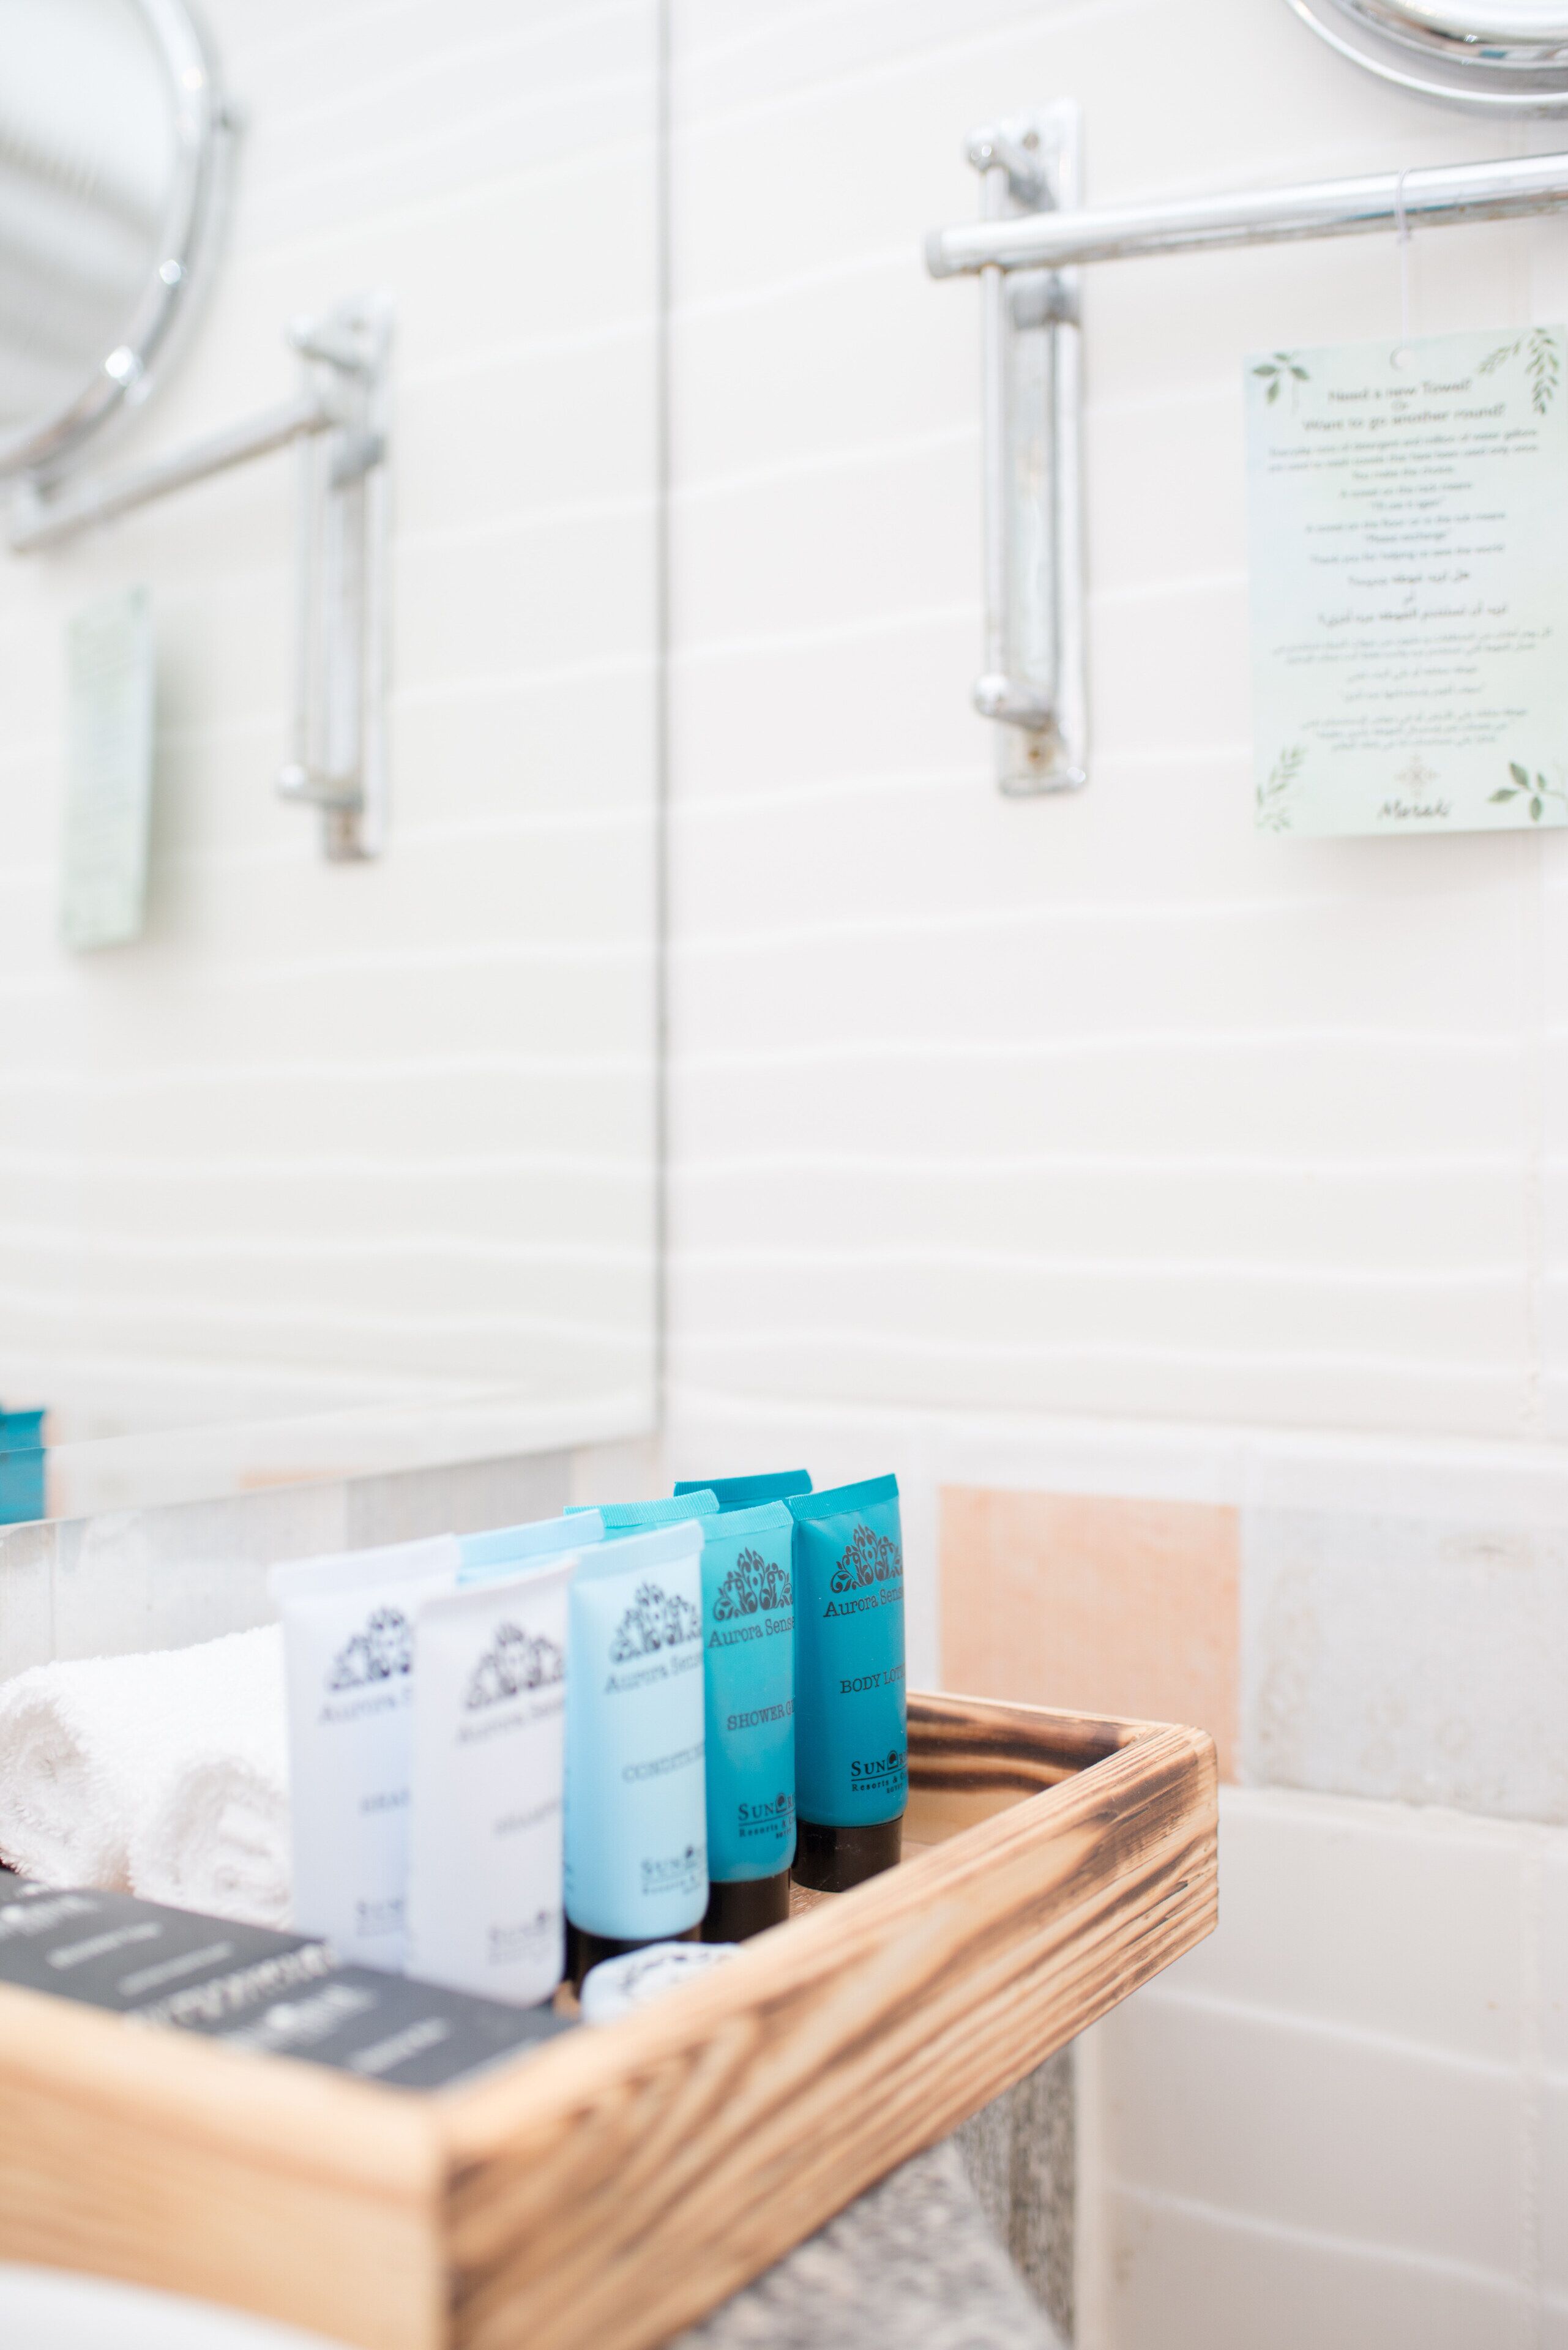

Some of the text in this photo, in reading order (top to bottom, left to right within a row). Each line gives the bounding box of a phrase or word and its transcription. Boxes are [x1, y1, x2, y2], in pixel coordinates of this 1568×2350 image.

[823, 1595, 878, 1617] Aurora
[708, 1625, 764, 1649] Aurora
[840, 1674, 881, 1694] BODY
[727, 1704, 785, 1730] SHOWER
[852, 1780, 889, 1791] Resorts
